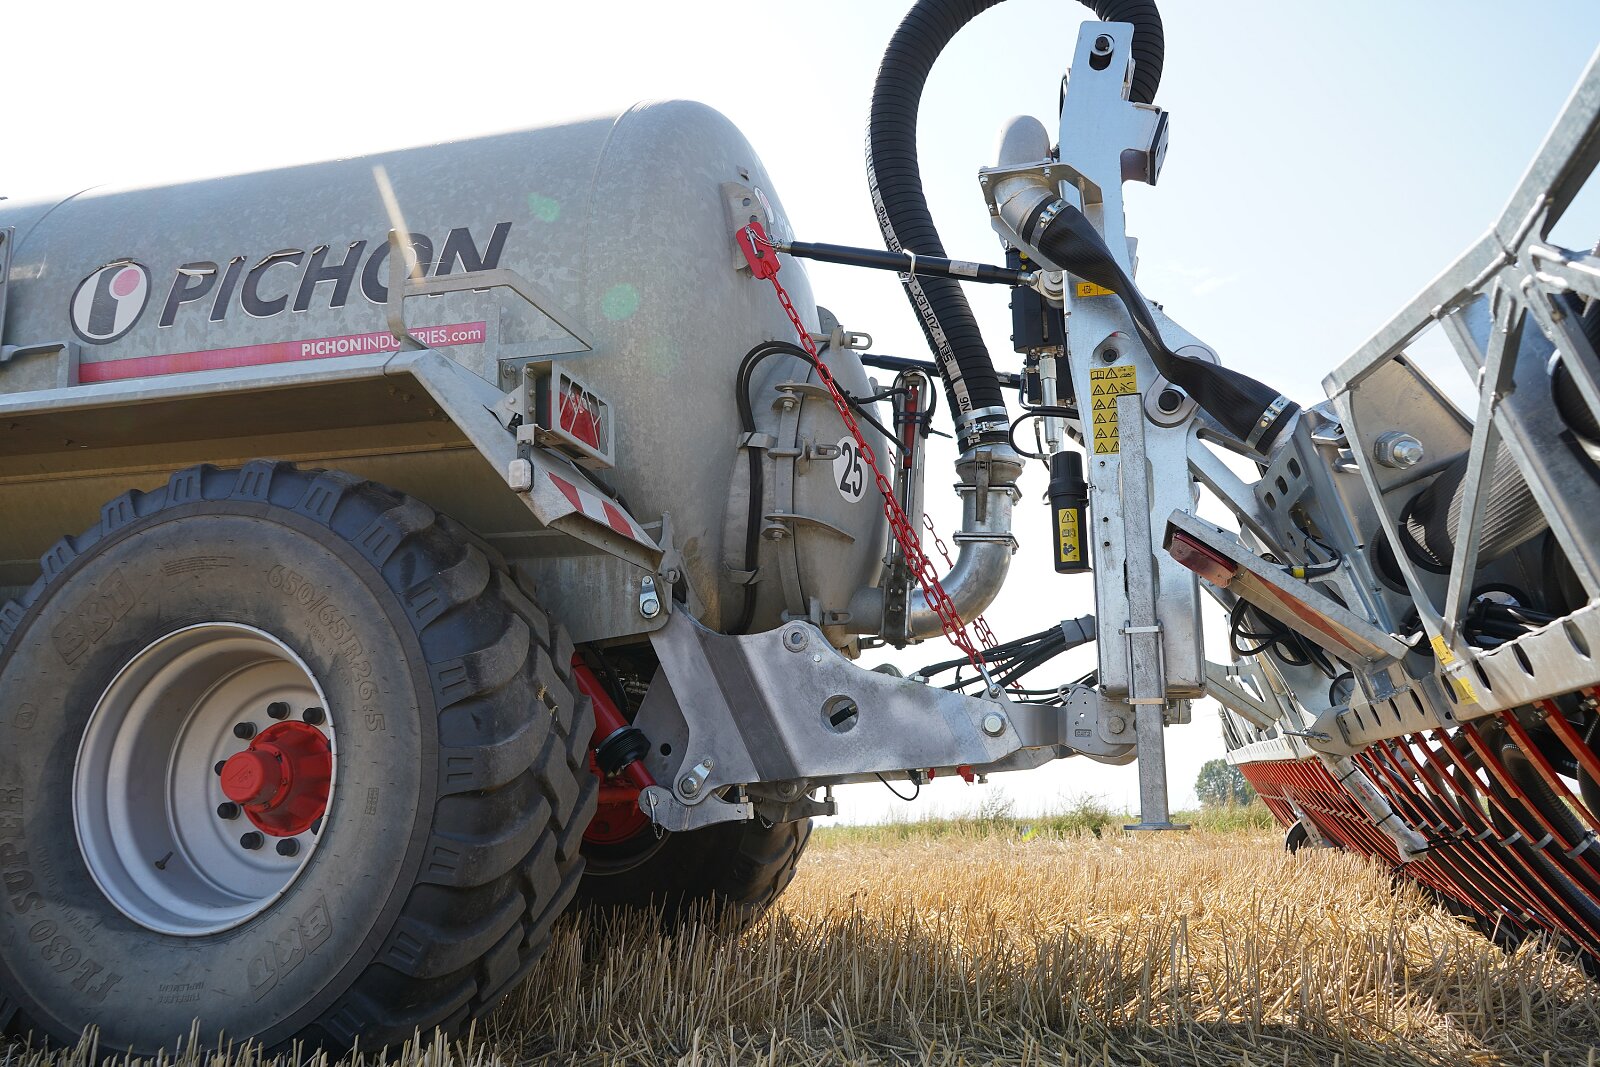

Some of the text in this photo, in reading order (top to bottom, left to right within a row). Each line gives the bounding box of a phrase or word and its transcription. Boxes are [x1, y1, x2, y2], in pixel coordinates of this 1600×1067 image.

[157, 221, 513, 329] PICHON
[913, 292, 941, 331] ZUFLEX
[301, 328, 481, 357] PICHONINDURIES.com
[959, 396, 973, 416] N6
[839, 441, 864, 498] 25
[266, 564, 387, 732] 650/65R26.5
[248, 894, 333, 1003] BKT
